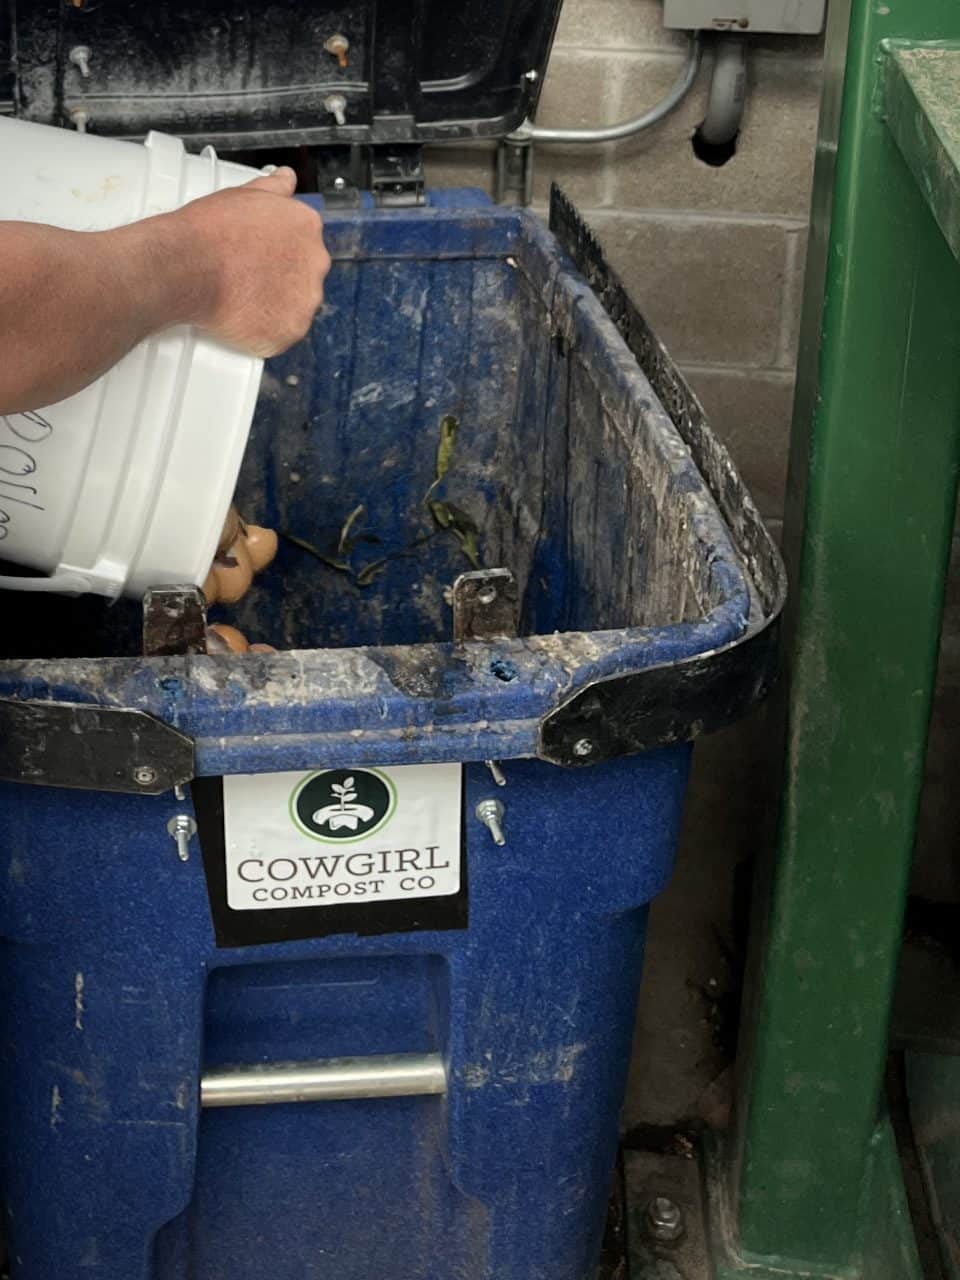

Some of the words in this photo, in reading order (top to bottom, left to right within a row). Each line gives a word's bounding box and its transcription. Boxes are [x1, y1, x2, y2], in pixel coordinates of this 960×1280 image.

[237, 846, 450, 883] COWGIRL
[252, 880, 384, 902] COMPOST
[399, 876, 436, 891] CO
